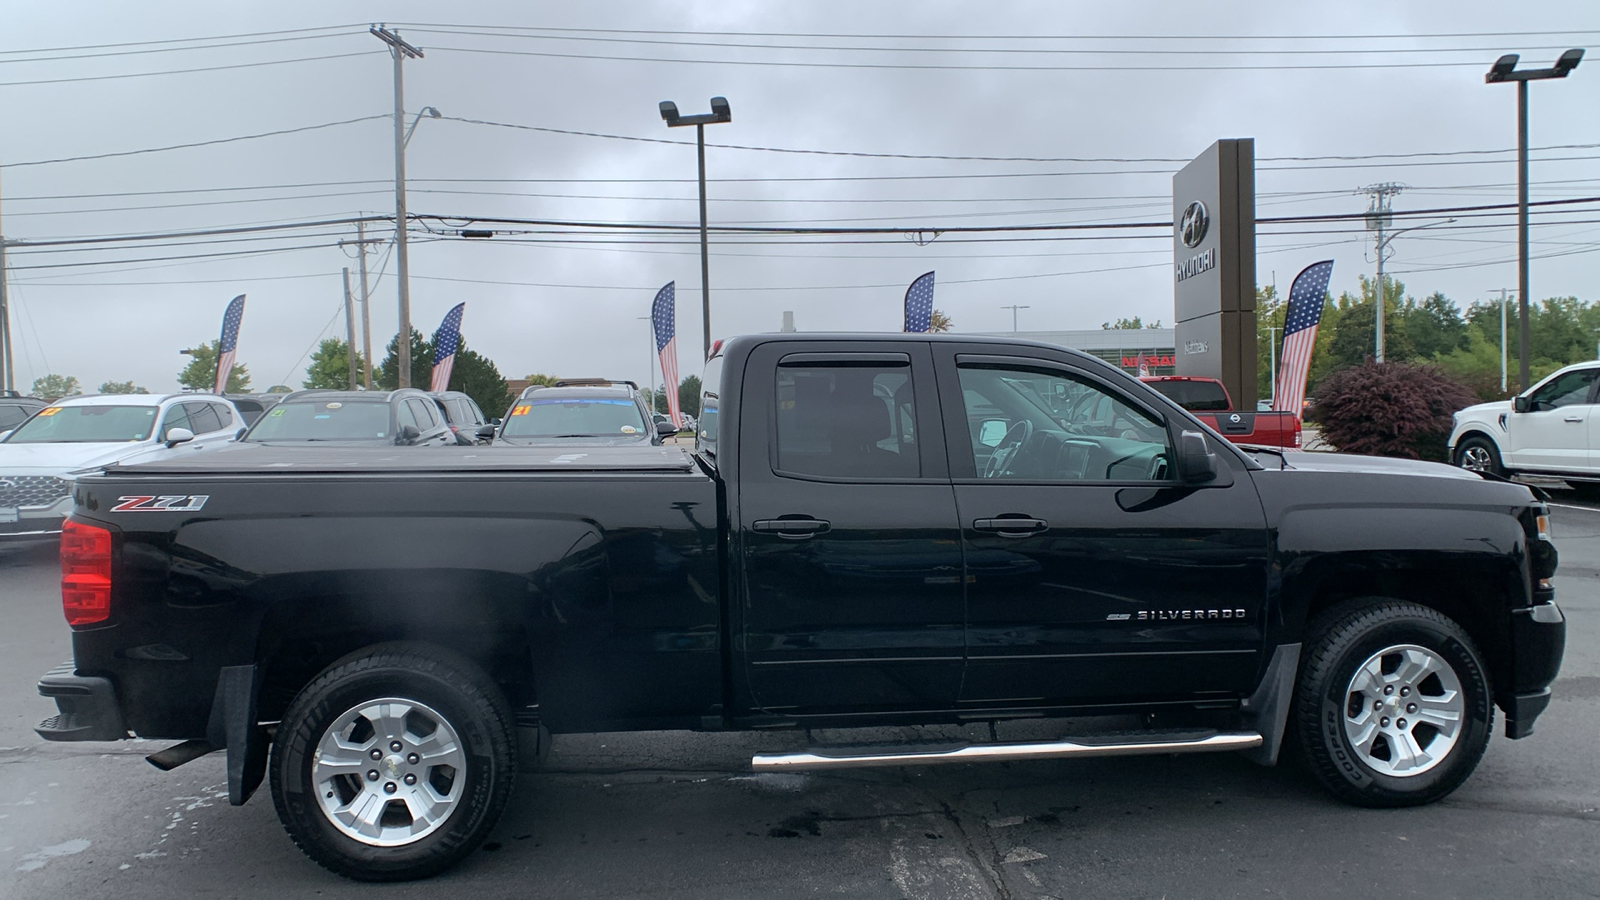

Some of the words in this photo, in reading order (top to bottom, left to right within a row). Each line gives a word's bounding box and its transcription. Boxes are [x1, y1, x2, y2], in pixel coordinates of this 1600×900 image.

[1177, 248, 1215, 282] HYUNDAI
[511, 405, 532, 416] 21
[109, 495, 210, 512] Z71
[1137, 608, 1246, 620] SILVERADO
[1327, 710, 1363, 781] COOPER
